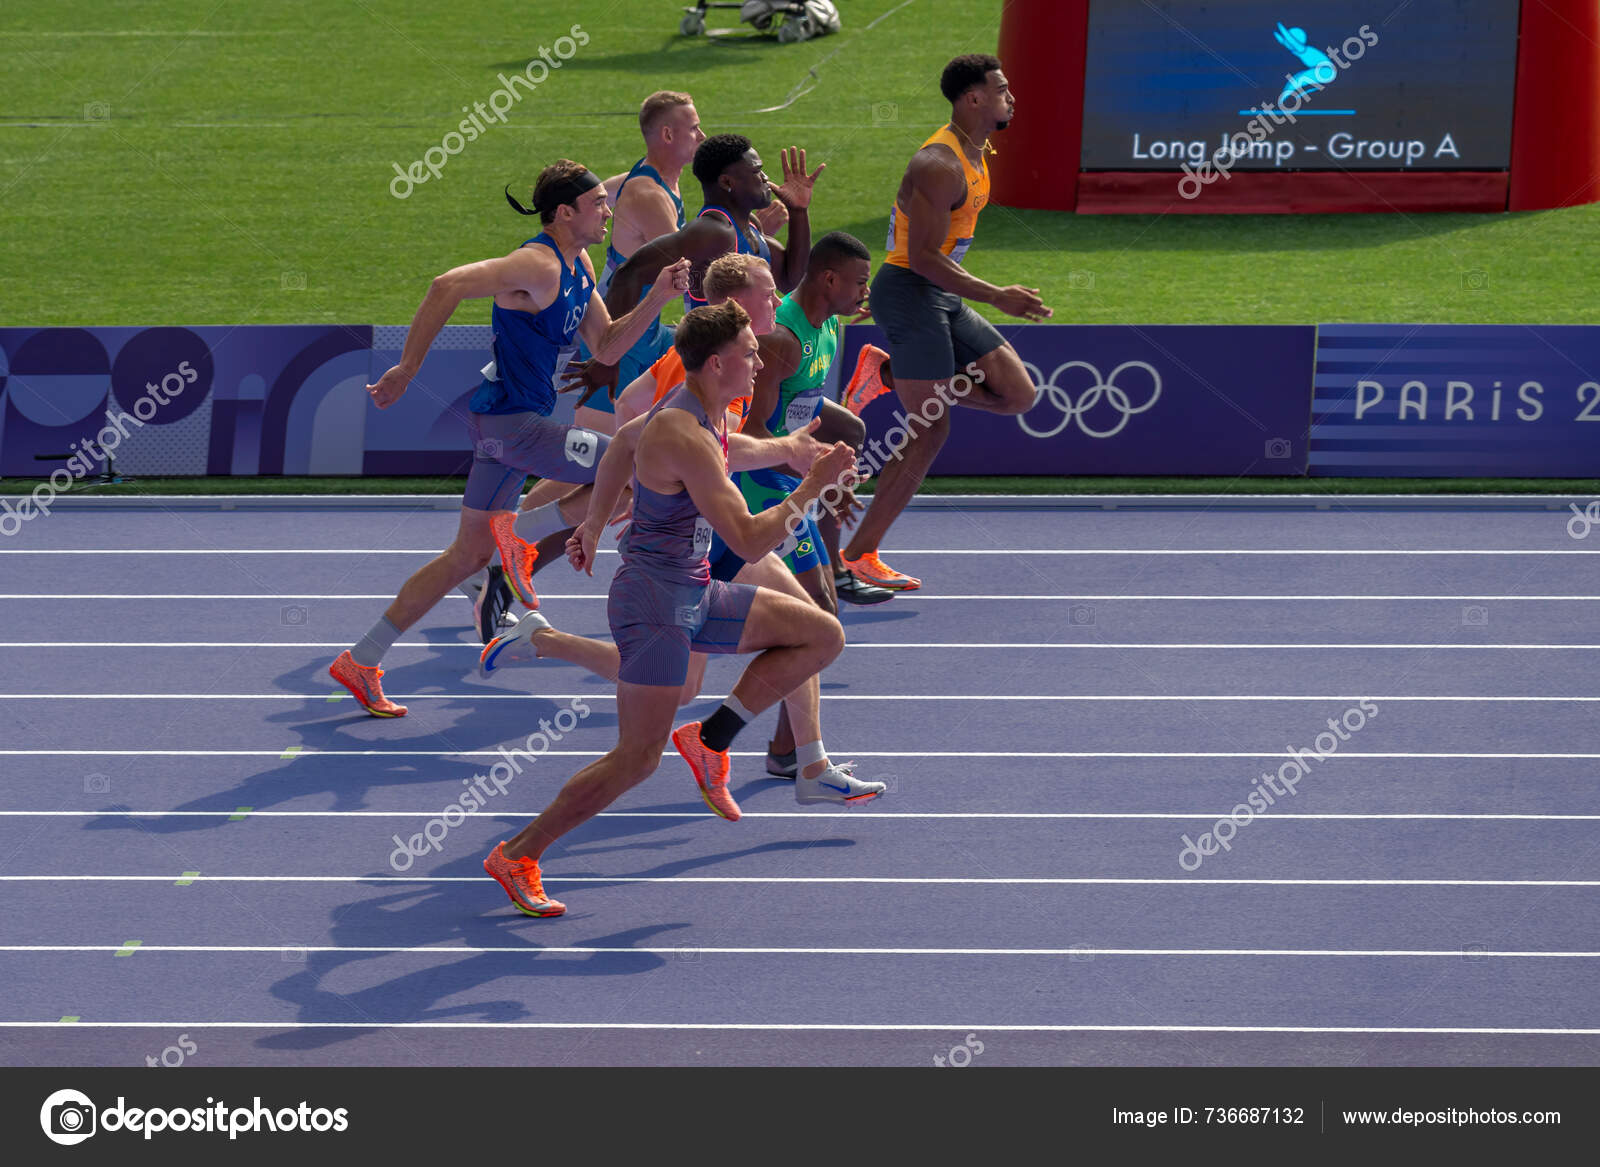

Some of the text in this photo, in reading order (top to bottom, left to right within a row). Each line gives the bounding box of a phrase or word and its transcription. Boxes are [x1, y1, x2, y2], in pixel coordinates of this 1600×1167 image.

[1133, 132, 1206, 167] Long
[1214, 132, 1294, 166] Jump
[1327, 131, 1425, 166] Group
[1433, 132, 1460, 158] A
[572, 442, 589, 454] 5
